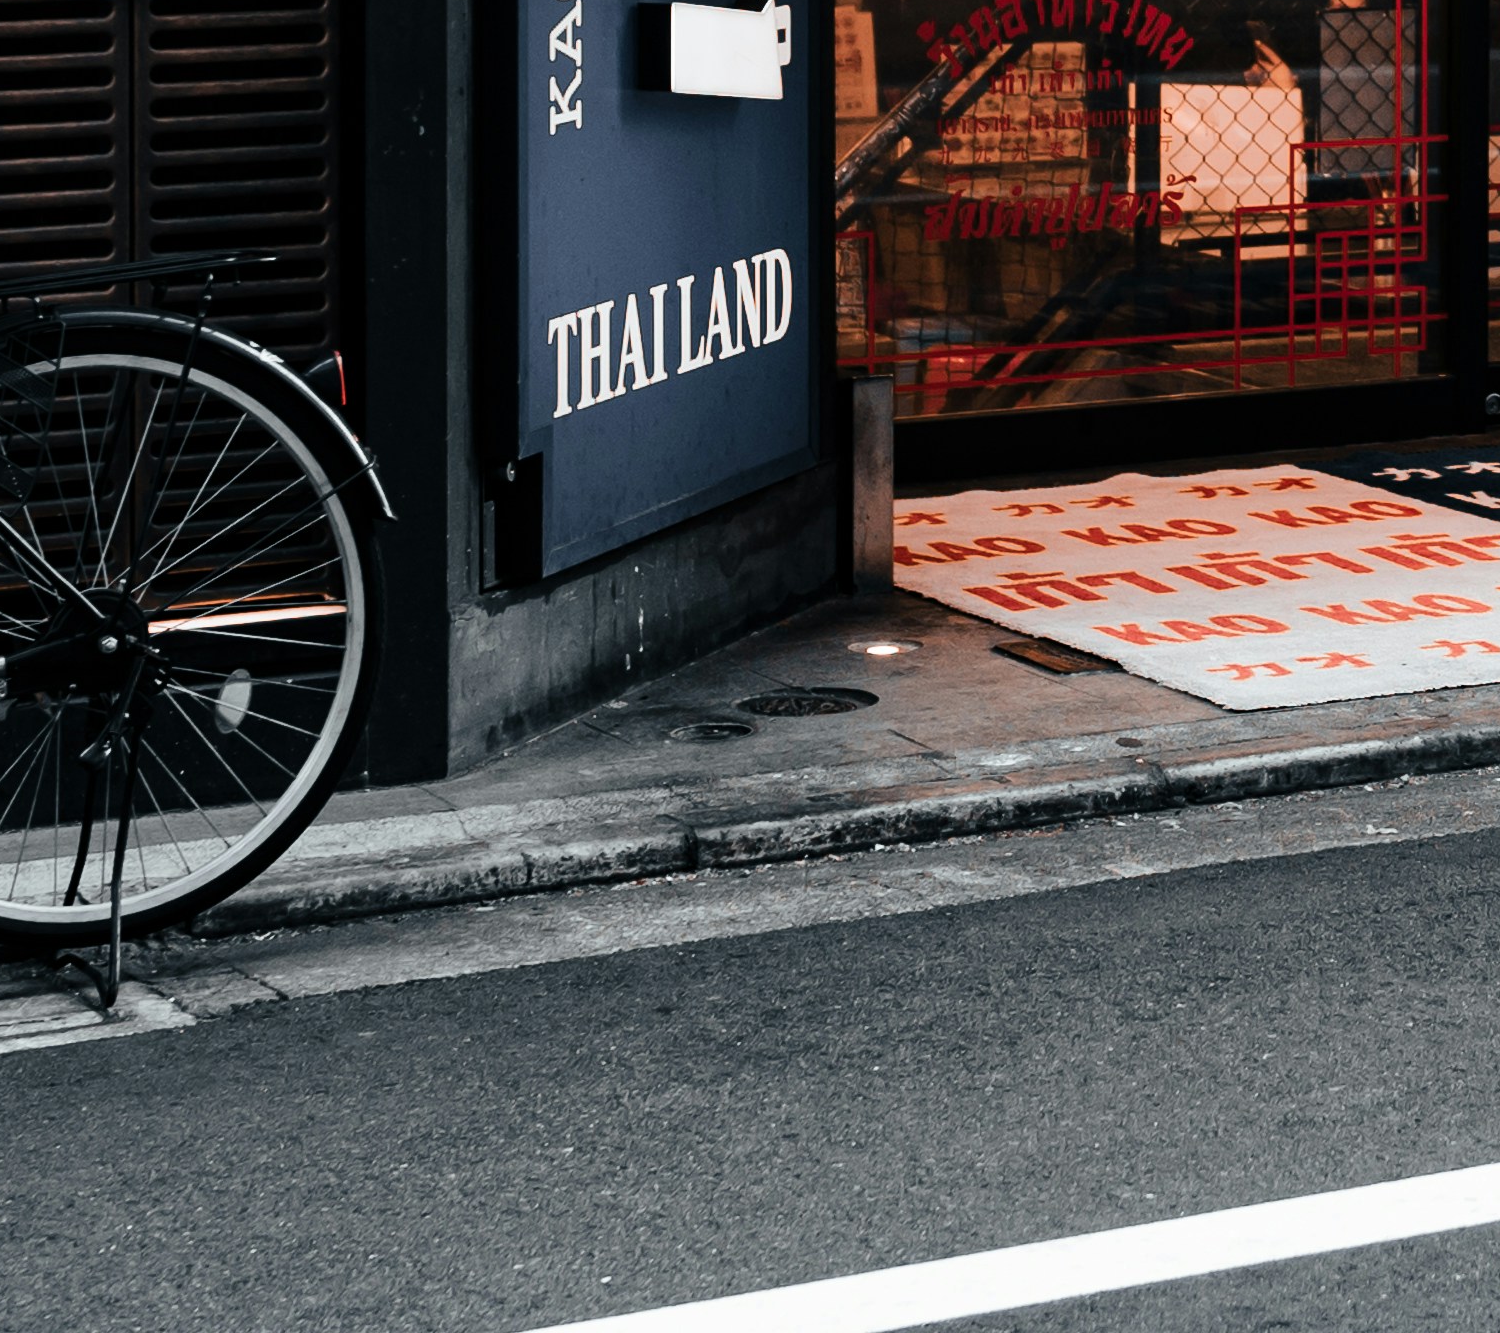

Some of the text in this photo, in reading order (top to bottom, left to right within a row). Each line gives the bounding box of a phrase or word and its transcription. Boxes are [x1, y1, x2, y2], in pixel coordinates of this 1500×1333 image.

[992, 477, 1317, 517] カオ カオ
[1061, 518, 1237, 546] KAO
[1247, 500, 1421, 528] KAO
[1093, 614, 1291, 646] KAO
[1300, 594, 1492, 625] KAO
[1205, 652, 1374, 681] カオ
